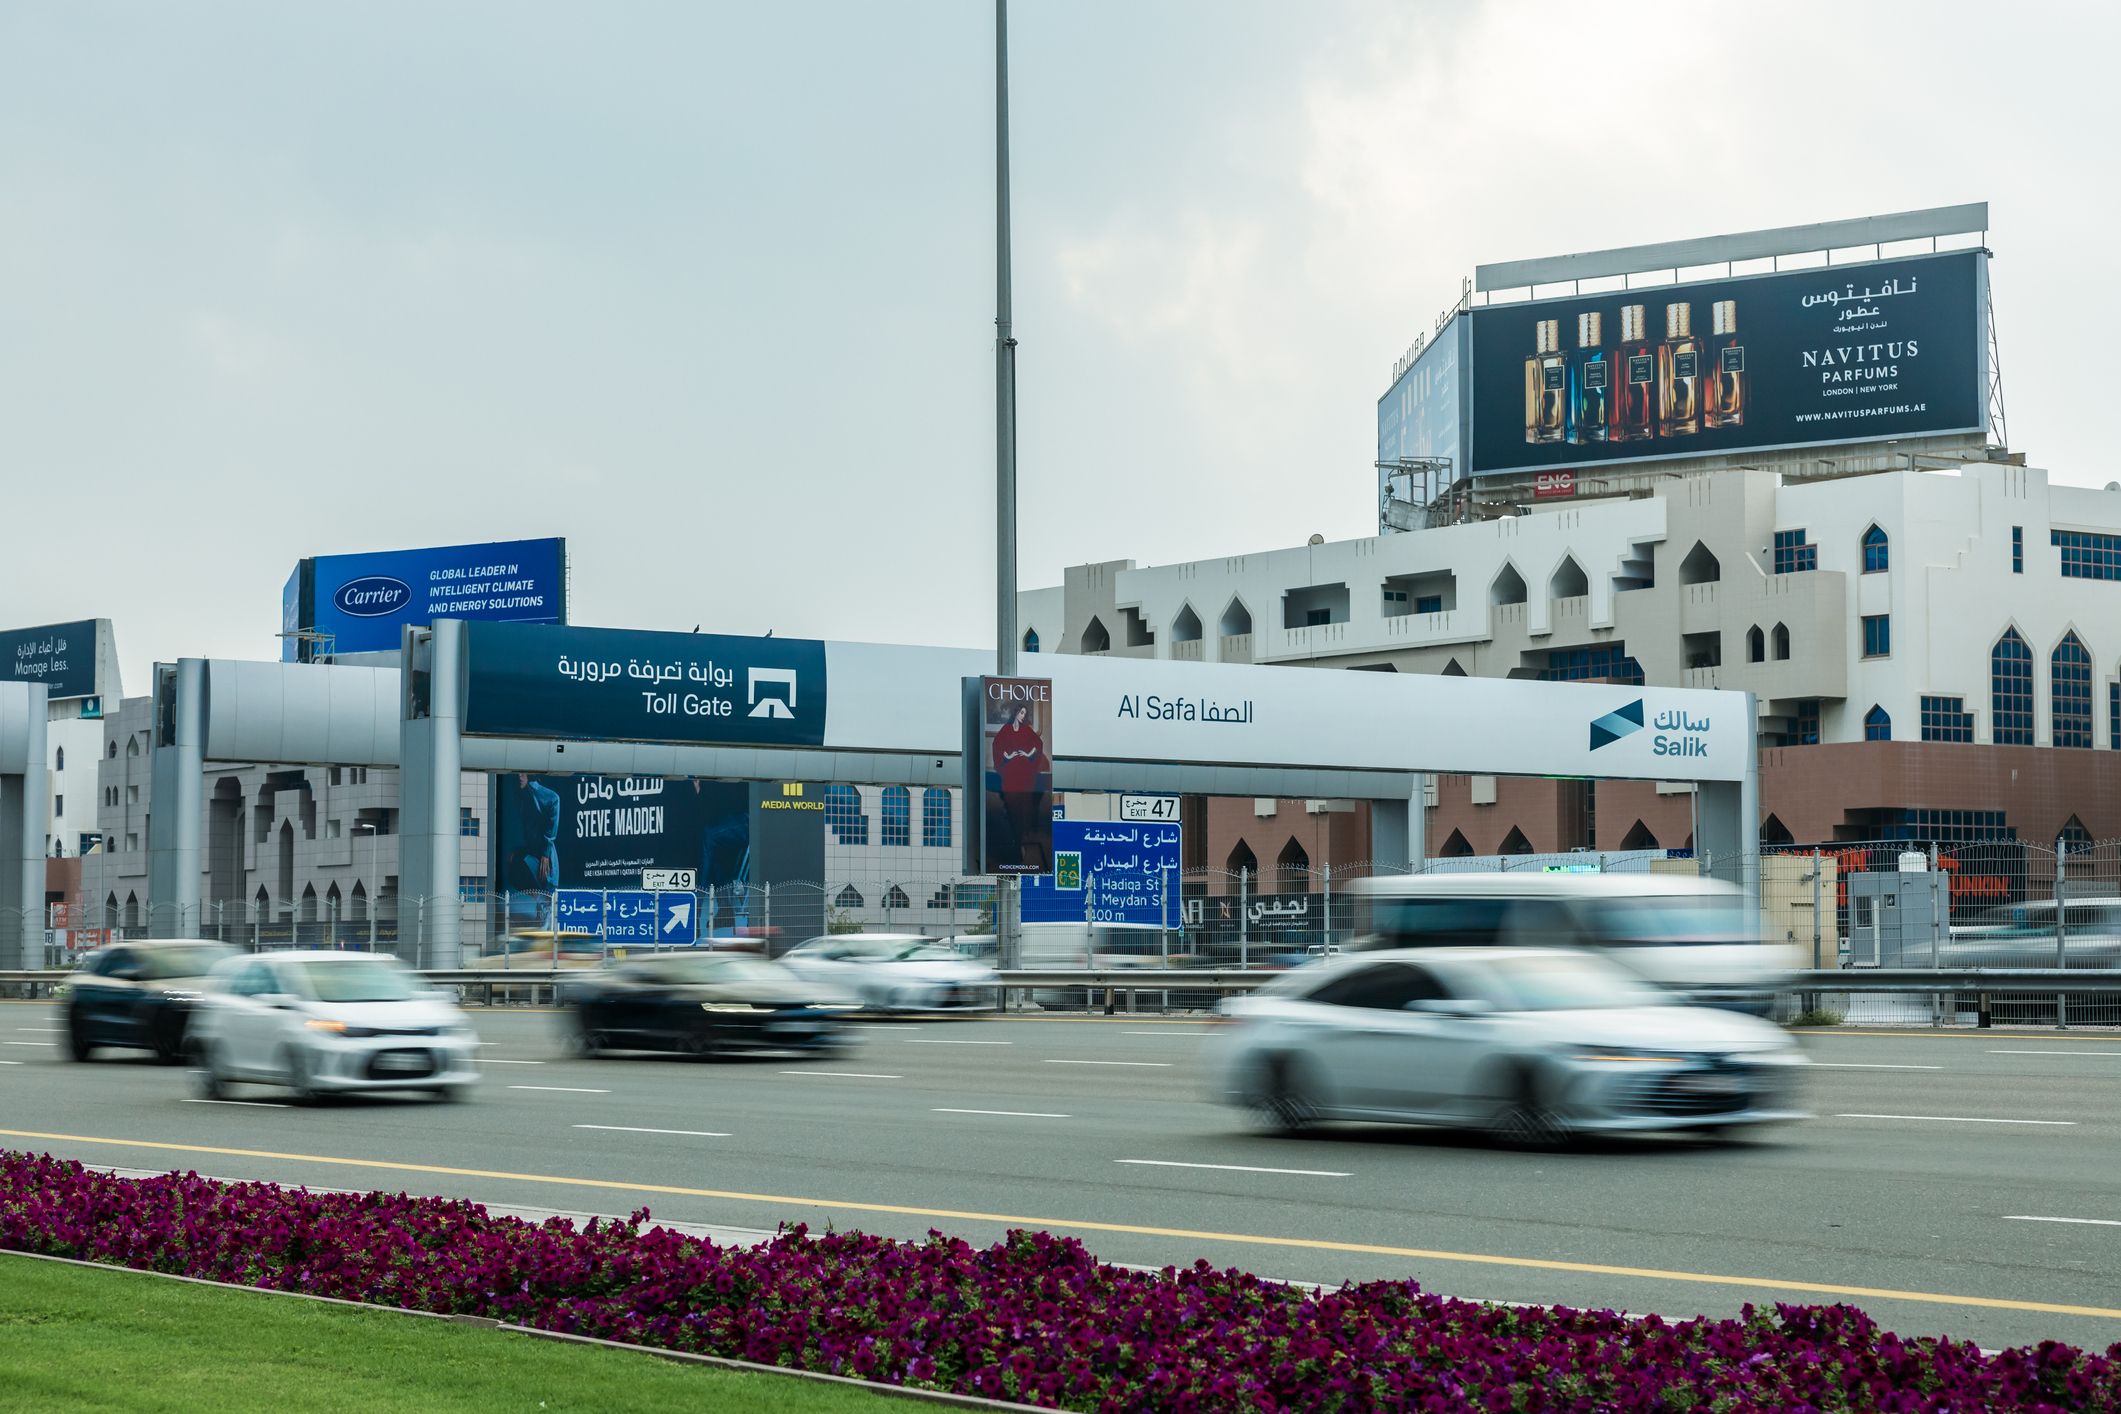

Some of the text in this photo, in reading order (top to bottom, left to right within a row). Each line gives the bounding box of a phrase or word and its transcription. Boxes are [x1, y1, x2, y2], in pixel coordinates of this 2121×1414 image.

[1802, 276, 1917, 307] نافيتوس
[1838, 306, 1880, 321] عطور
[1869, 320, 1887, 330] لندن
[1802, 340, 1919, 368] NAVITUS
[1822, 365, 1898, 384] PARFUMS
[1822, 383, 1899, 397] LONDON NEW YORK
[1795, 403, 1927, 423] WWW.NAVITUSPARFUMS.AE
[429, 564, 518, 580] GLOBAL LEADER IN
[344, 586, 402, 606] Carrier
[429, 580, 534, 597] INTELLIGENT CLIMATE
[428, 596, 543, 614] AND ENERGY SOLUTIONS
[54, 639, 67, 655] قلل
[14, 656, 69, 678] Manage Less.
[558, 655, 733, 688] بوابة تعرفة مرورية
[988, 682, 1050, 702] CHOICE
[642, 692, 732, 717] Toll Gate
[1117, 694, 1196, 721] Al Safa
[1201, 698, 1253, 724] الصفا
[1653, 710, 1710, 732] سالك
[1652, 735, 1708, 757] Salik
[577, 776, 614, 805] مادن
[761, 800, 825, 810] MEDIA WORLD
[1125, 798, 1147, 808] مخرج
[1130, 808, 1147, 817] EXIT
[1152, 799, 1175, 818] 47
[576, 806, 664, 838] STEVE MADDEN
[1084, 827, 1178, 849] شارع الحديقة
[1093, 853, 1178, 874] شارع الميدان
[669, 872, 691, 888] 49
[1101, 877, 1141, 894] Hadiqa
[1146, 878, 1159, 891] St
[560, 898, 599, 916] عمارة
[619, 899, 656, 919] شارع
[1101, 893, 1147, 909] Meydan
[1115, 912, 1125, 921] m
[1180, 899, 1204, 924] AFI
[557, 922, 654, 936] Umm Amara St
